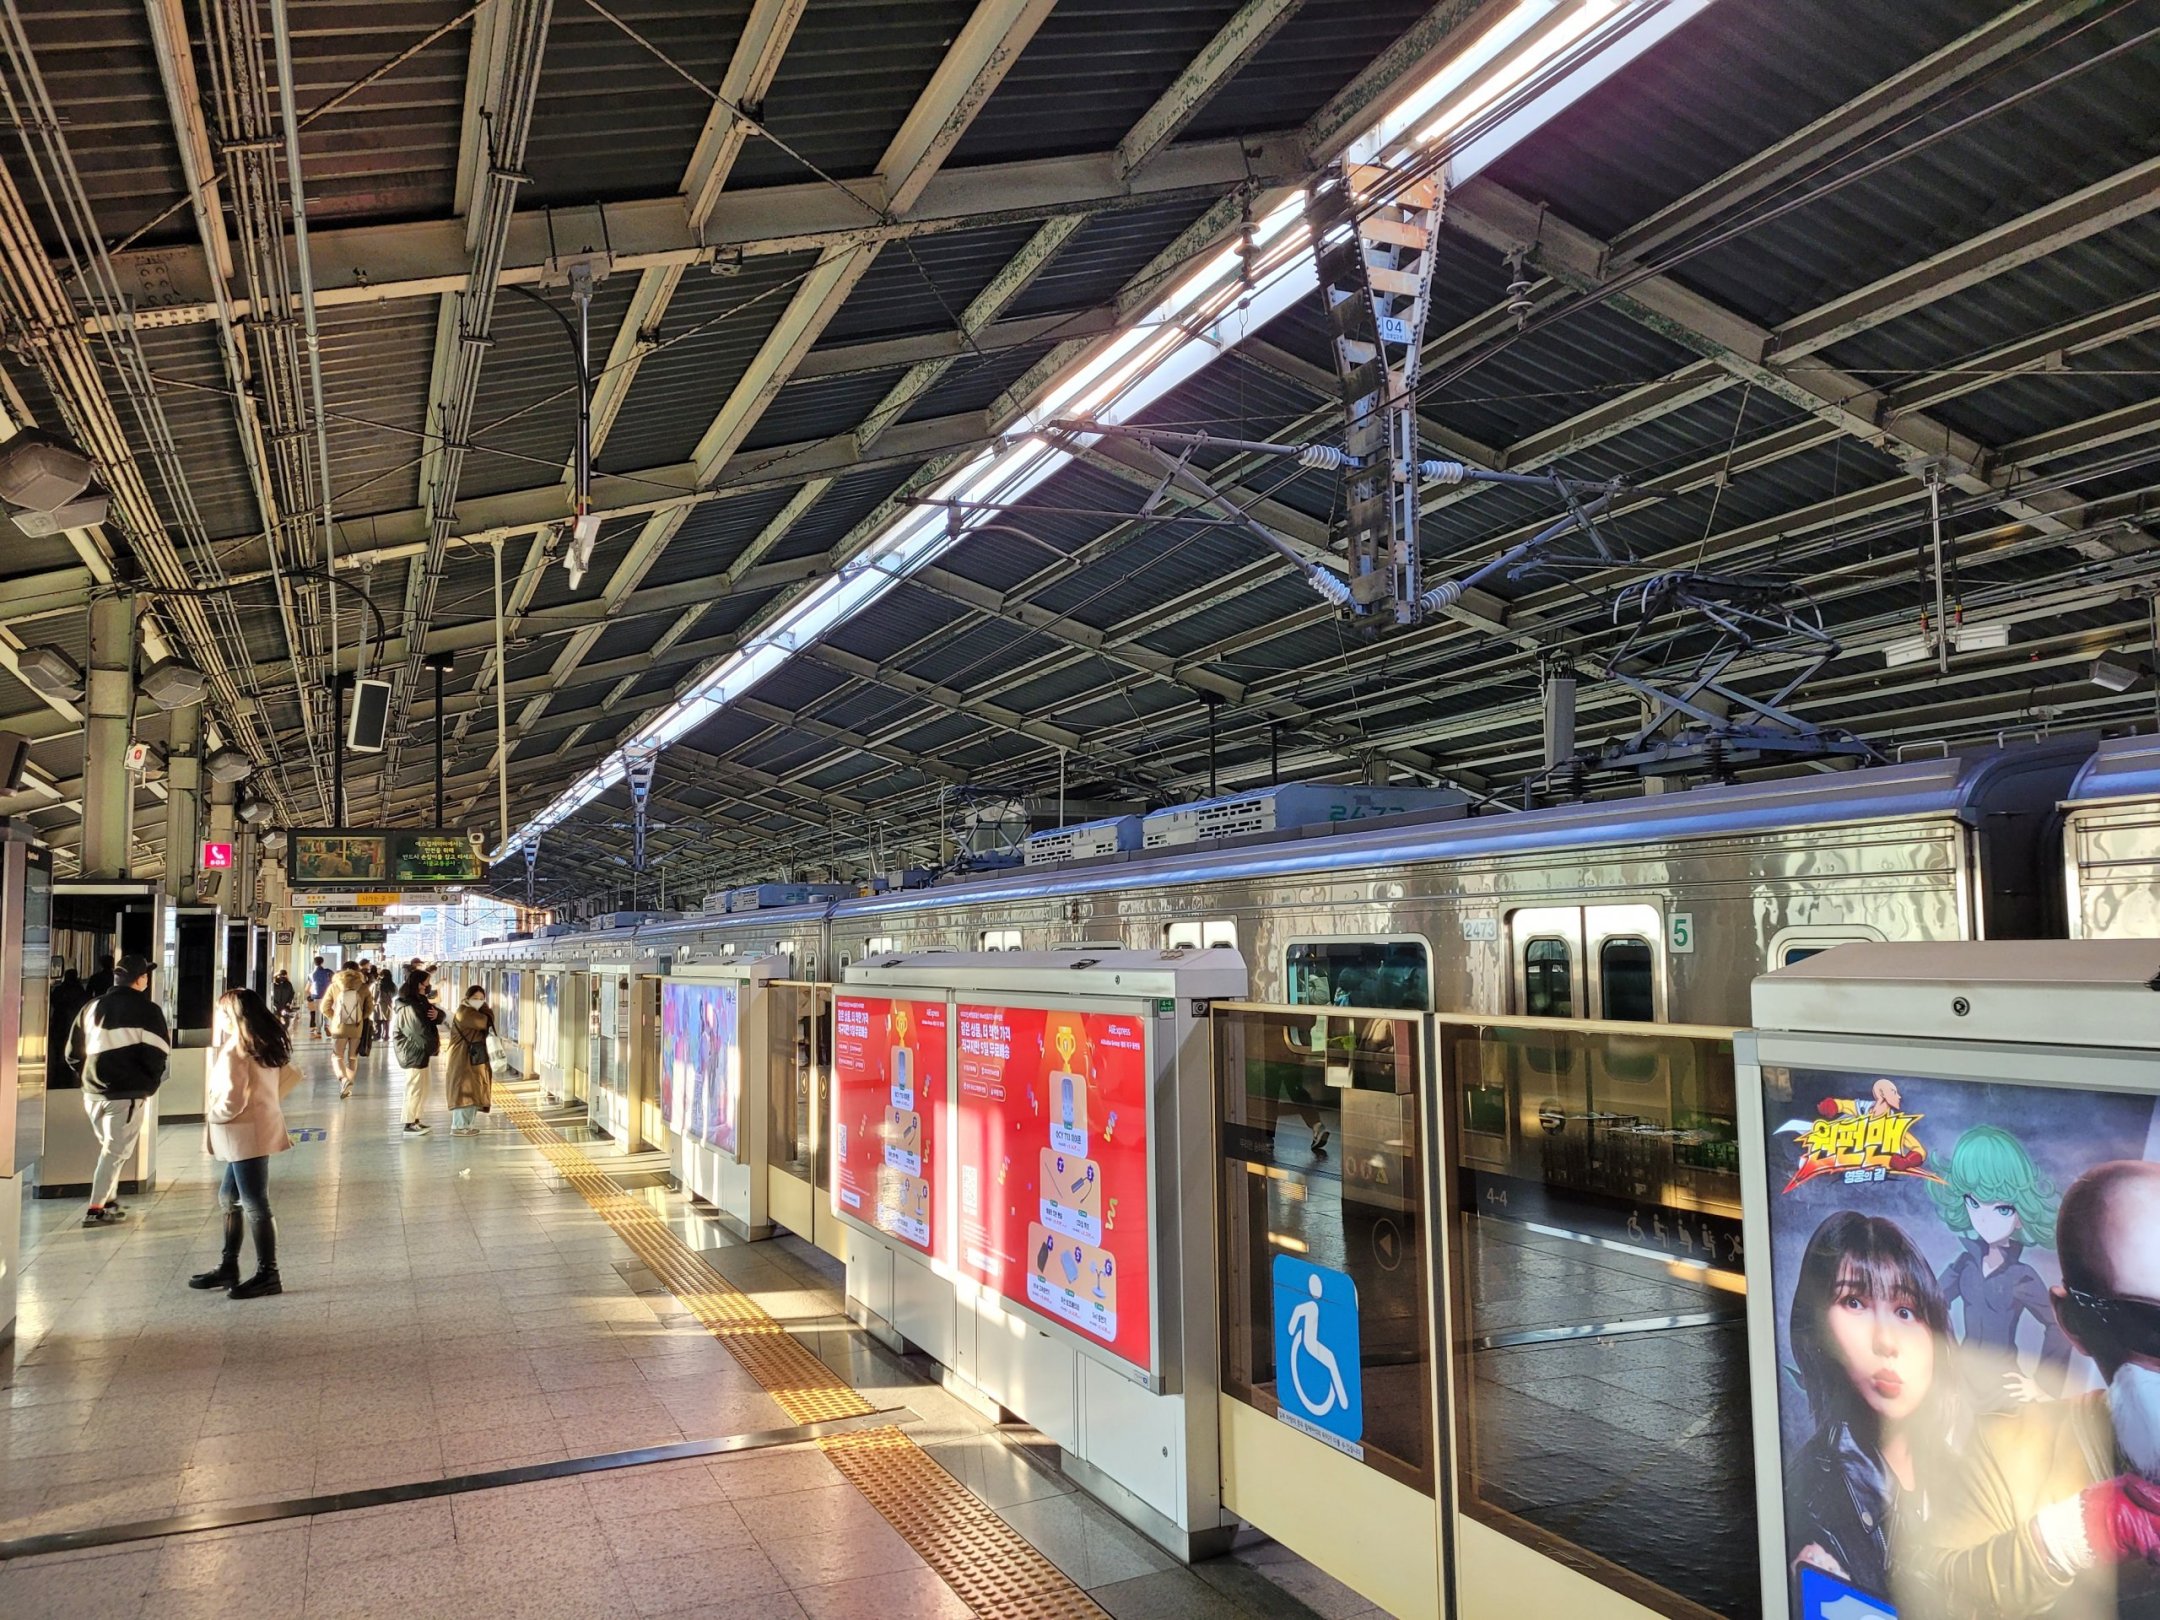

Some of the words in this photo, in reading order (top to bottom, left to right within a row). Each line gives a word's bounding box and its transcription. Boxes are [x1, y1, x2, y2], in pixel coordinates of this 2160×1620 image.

[1386, 320, 1402, 333] 04
[1465, 922, 1495, 938] 2473
[1674, 919, 1688, 947] 5
[1108, 1024, 1131, 1037] AliExpress
[1808, 1117, 1914, 1168] 원펀맨
[1844, 1170, 1873, 1184] 영웅의
[1873, 1168, 1886, 1181] 길
[1487, 1187, 1508, 1208] 4-4
